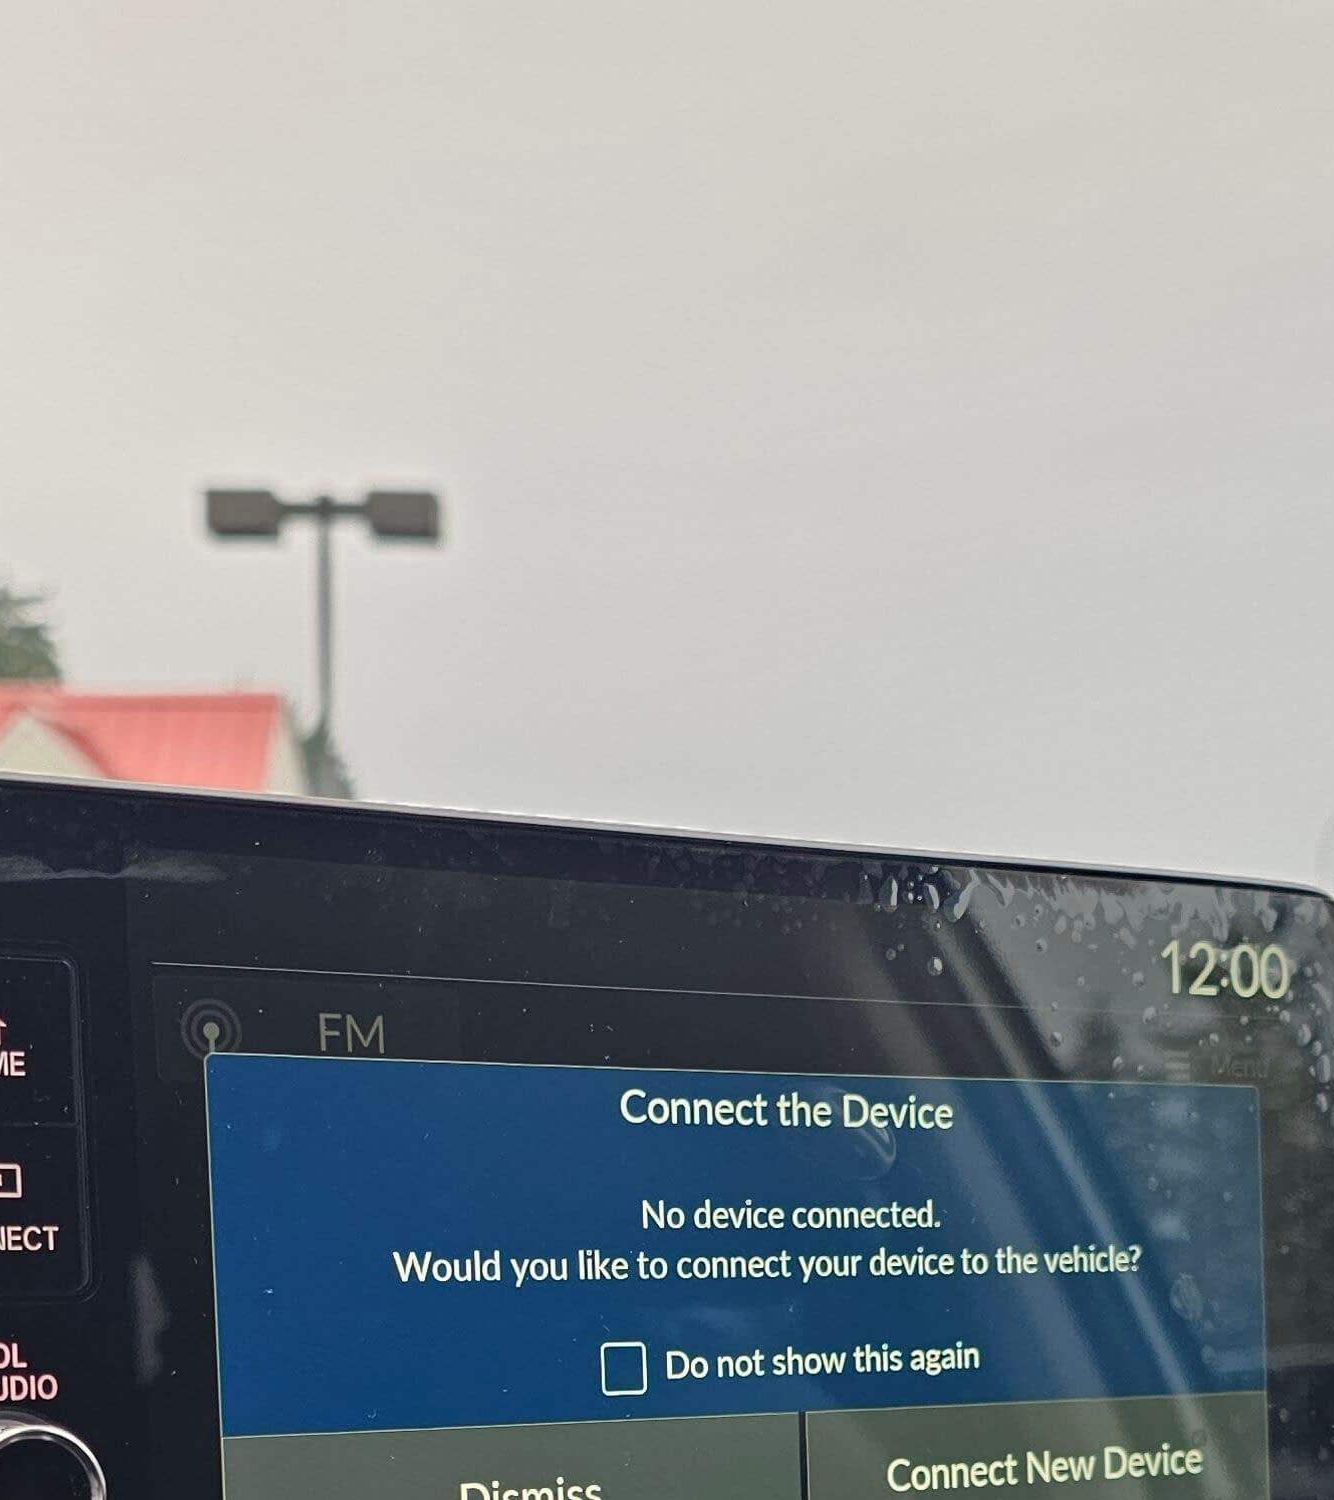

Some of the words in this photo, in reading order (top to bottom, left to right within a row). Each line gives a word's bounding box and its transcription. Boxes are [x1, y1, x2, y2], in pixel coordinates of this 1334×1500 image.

[1161, 939, 1291, 999] 12:00
[318, 1013, 386, 1055] FM
[620, 1088, 768, 1127] Connect
[776, 1091, 832, 1128] the
[843, 1093, 954, 1130] Device
[642, 1199, 685, 1229] No
[693, 1198, 785, 1229] device
[792, 1198, 941, 1229] connected.
[392, 1249, 501, 1282] Would
[510, 1258, 568, 1288] you
[578, 1249, 629, 1280] like
[636, 1251, 668, 1280] to
[676, 1249, 792, 1279] connect
[798, 1254, 863, 1284] your
[869, 1246, 955, 1276] device
[960, 1248, 989, 1275] to
[994, 1245, 1038, 1274] the
[1043, 1243, 1142, 1274] vehicle?
[666, 1350, 707, 1380] Do
[717, 1349, 765, 1378] not
[772, 1346, 847, 1376] show
[852, 1343, 903, 1373] this
[910, 1340, 980, 1376] again
[887, 1453, 1019, 1492] Connect
[1026, 1450, 1096, 1485] New
[1103, 1442, 1204, 1480] Device
